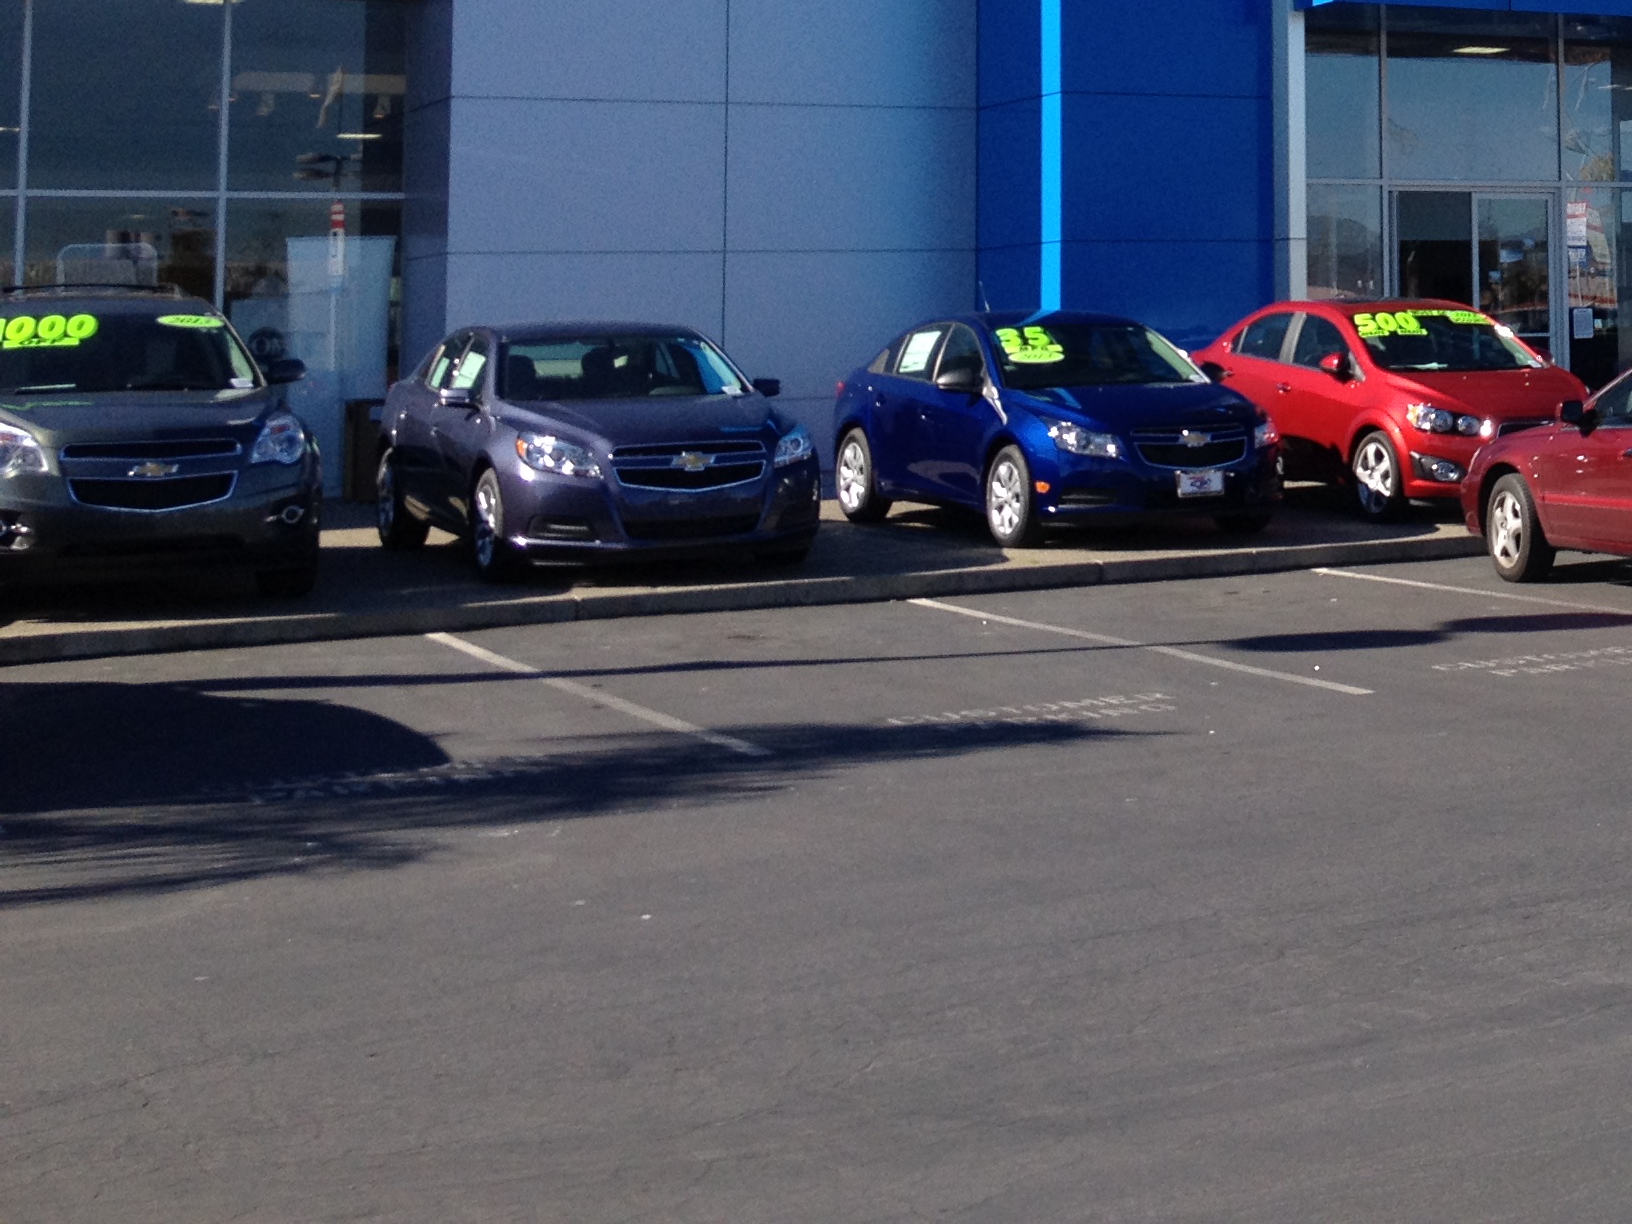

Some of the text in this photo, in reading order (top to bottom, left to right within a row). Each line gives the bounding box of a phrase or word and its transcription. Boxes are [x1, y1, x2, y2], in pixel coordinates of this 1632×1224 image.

[0, 314, 97, 341] 000
[1353, 312, 1421, 332] 500
[996, 326, 1050, 347] 35
[886, 691, 1177, 726] CUSTOMER
